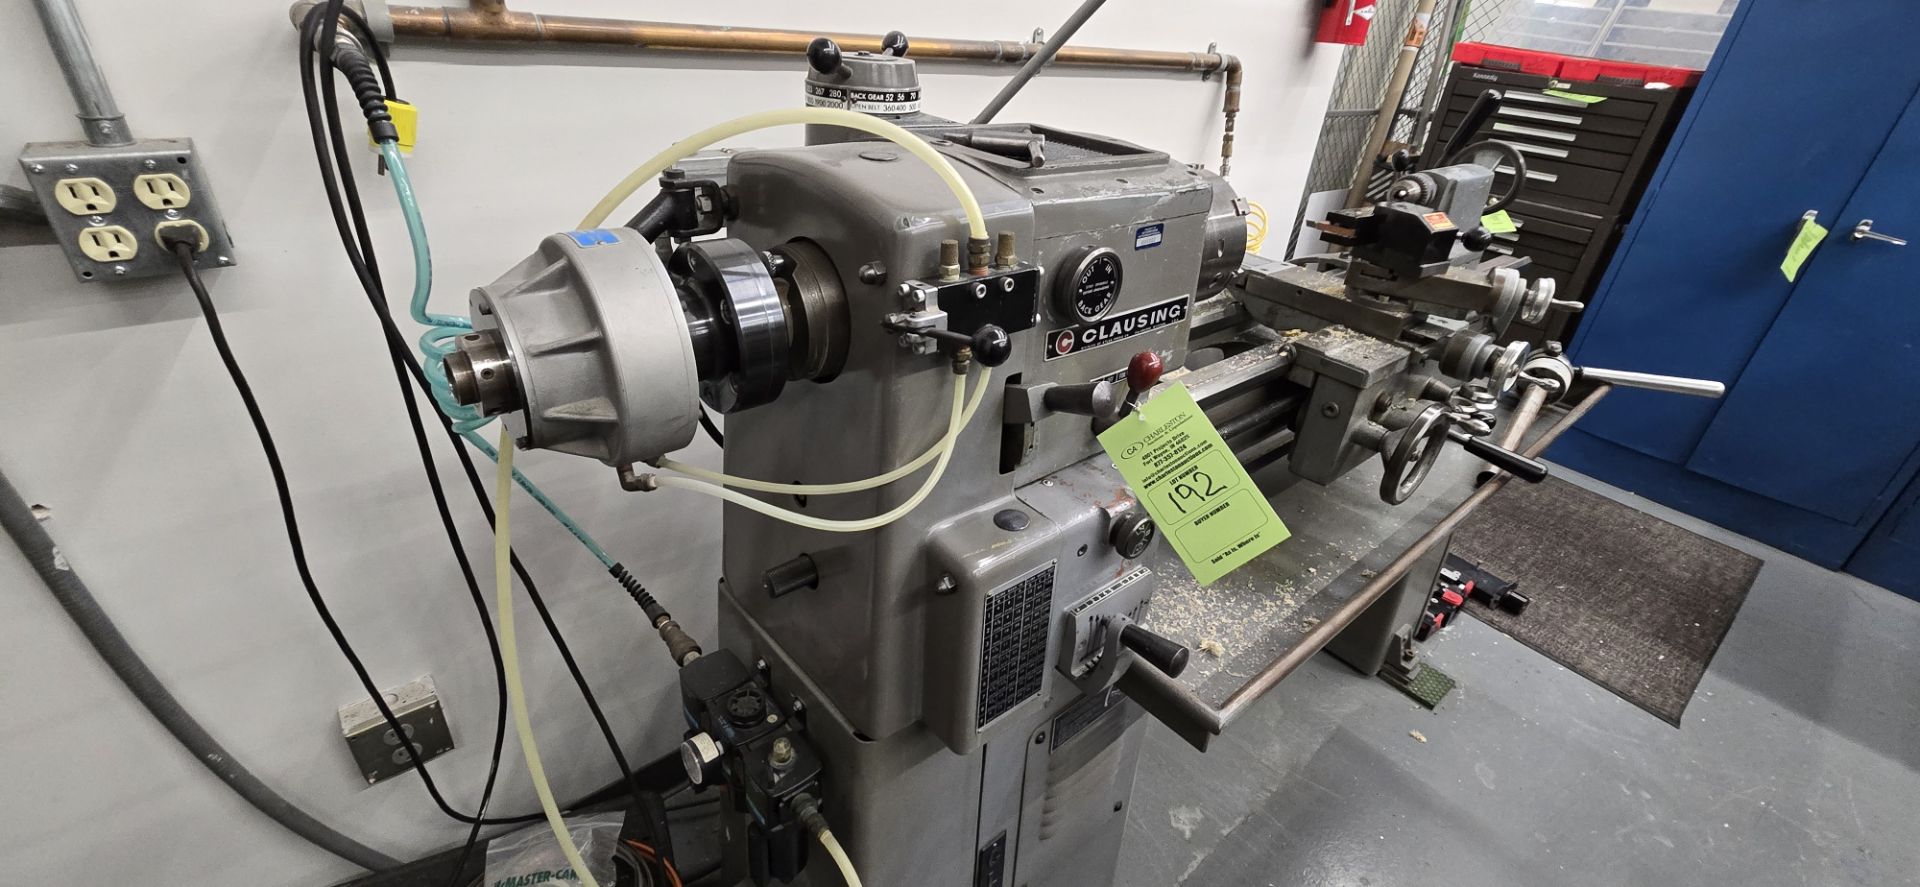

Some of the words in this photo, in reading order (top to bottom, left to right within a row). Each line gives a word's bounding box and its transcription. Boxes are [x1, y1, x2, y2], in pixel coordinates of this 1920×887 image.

[829, 89, 842, 98] 280
[850, 92, 866, 100] BACK
[867, 93, 884, 101] GEAR
[885, 93, 894, 102] 52
[897, 93, 905, 101] 56
[910, 92, 917, 100] 70
[827, 100, 844, 109] 2000
[883, 104, 896, 112] 360
[1082, 265, 1095, 284] OUT
[1105, 264, 1113, 275] IN
[1078, 300, 1092, 315] BACK
[1095, 292, 1112, 313] GEAR
[1082, 304, 1181, 344] CLAUSING
[1143, 411, 1186, 443] CHARLESTON
[1172, 431, 1185, 441] Drive
[1127, 446, 1138, 456] CA
[1143, 458, 1154, 466] Fort
[1143, 443, 1214, 489] www.charlestonauctions.com
[1169, 477, 1179, 486] LOT
[1178, 464, 1199, 480] NUMBER
[1168, 471, 1228, 514] 192
[1194, 513, 1210, 526] BUYER
[1209, 501, 1230, 516] NUMBER
[1211, 555, 1223, 564] Sold
[1237, 536, 1255, 549] Where
